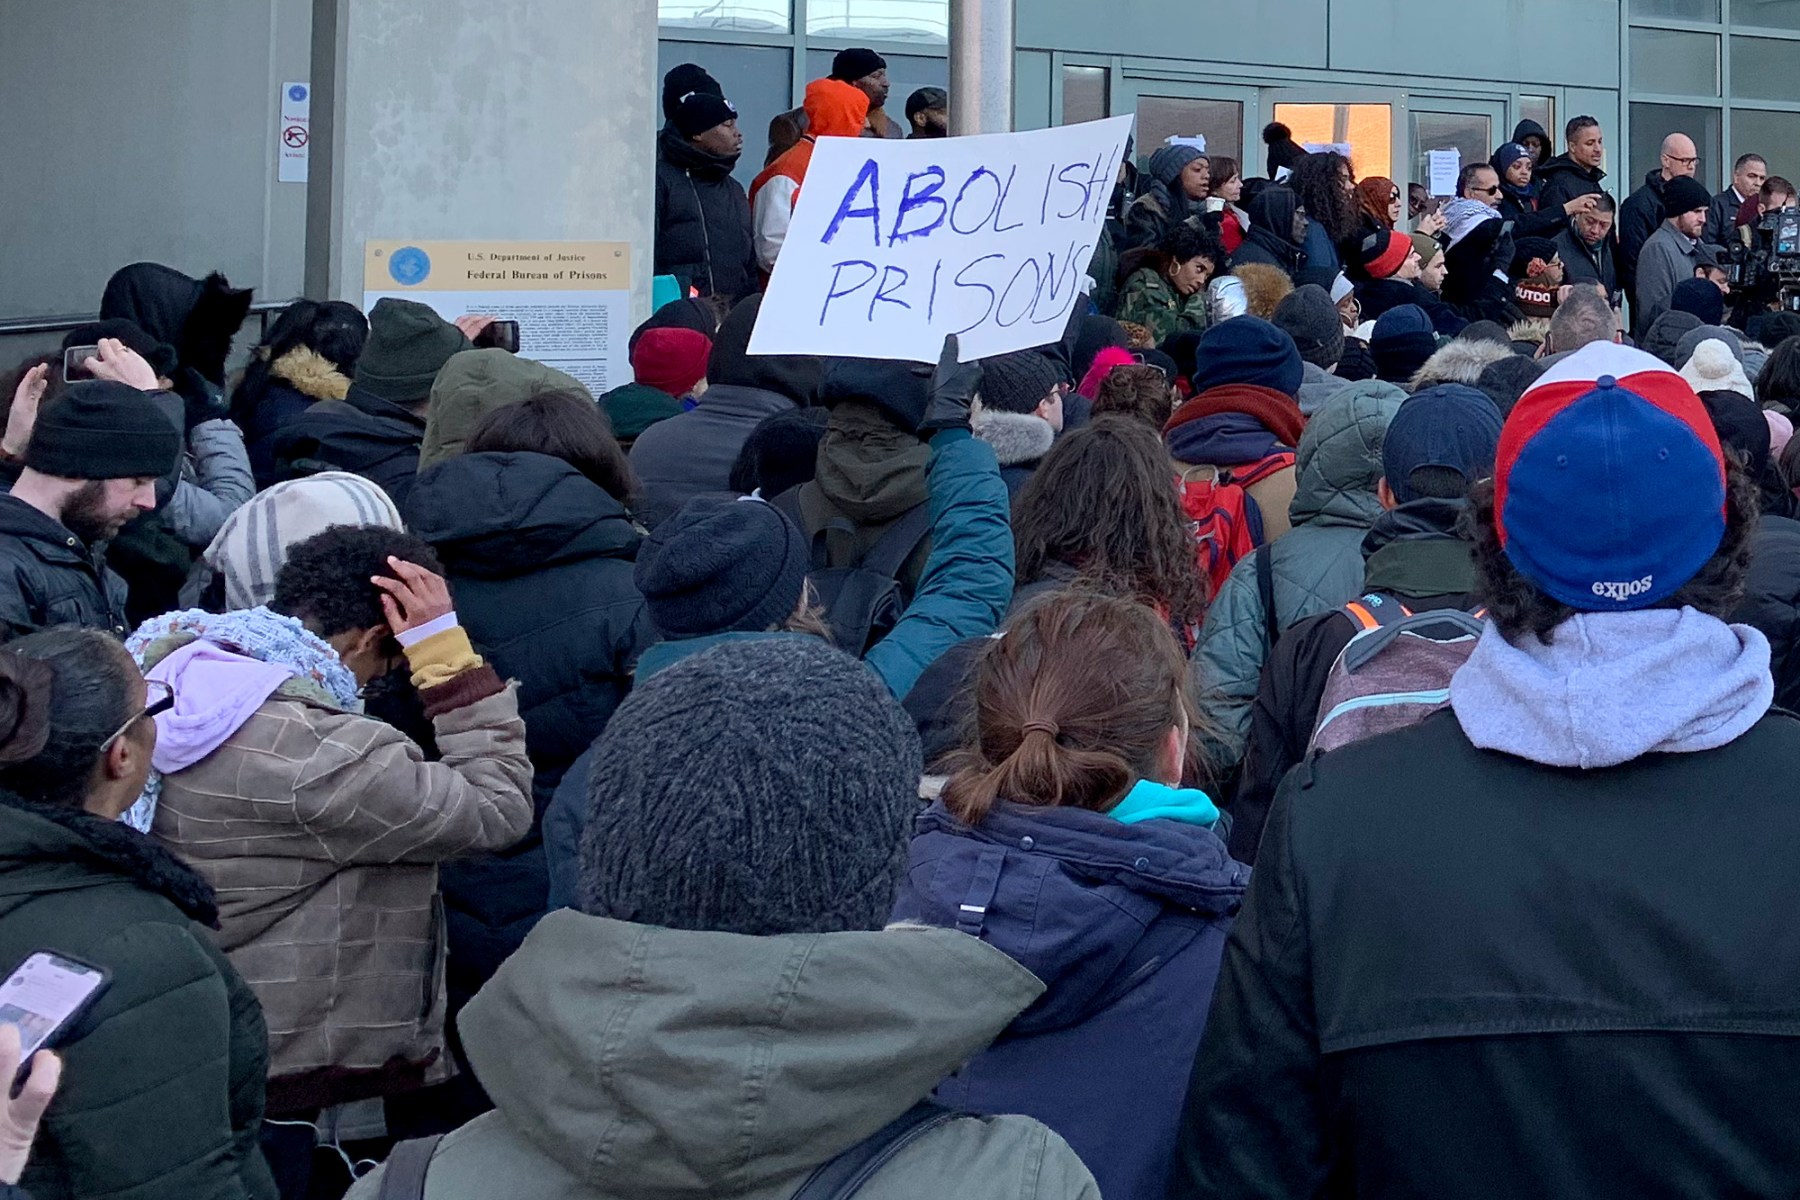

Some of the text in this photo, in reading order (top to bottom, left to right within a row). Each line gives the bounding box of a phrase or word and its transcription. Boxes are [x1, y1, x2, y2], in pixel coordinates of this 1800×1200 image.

[820, 143, 1119, 248] ABOLISH
[490, 253, 540, 262] Department
[544, 253, 552, 261] of
[556, 253, 586, 261] Justice
[467, 270, 608, 279] Federal Bureau of Prisons
[819, 240, 1091, 335] PRISONS
[1591, 574, 1653, 601] expos
